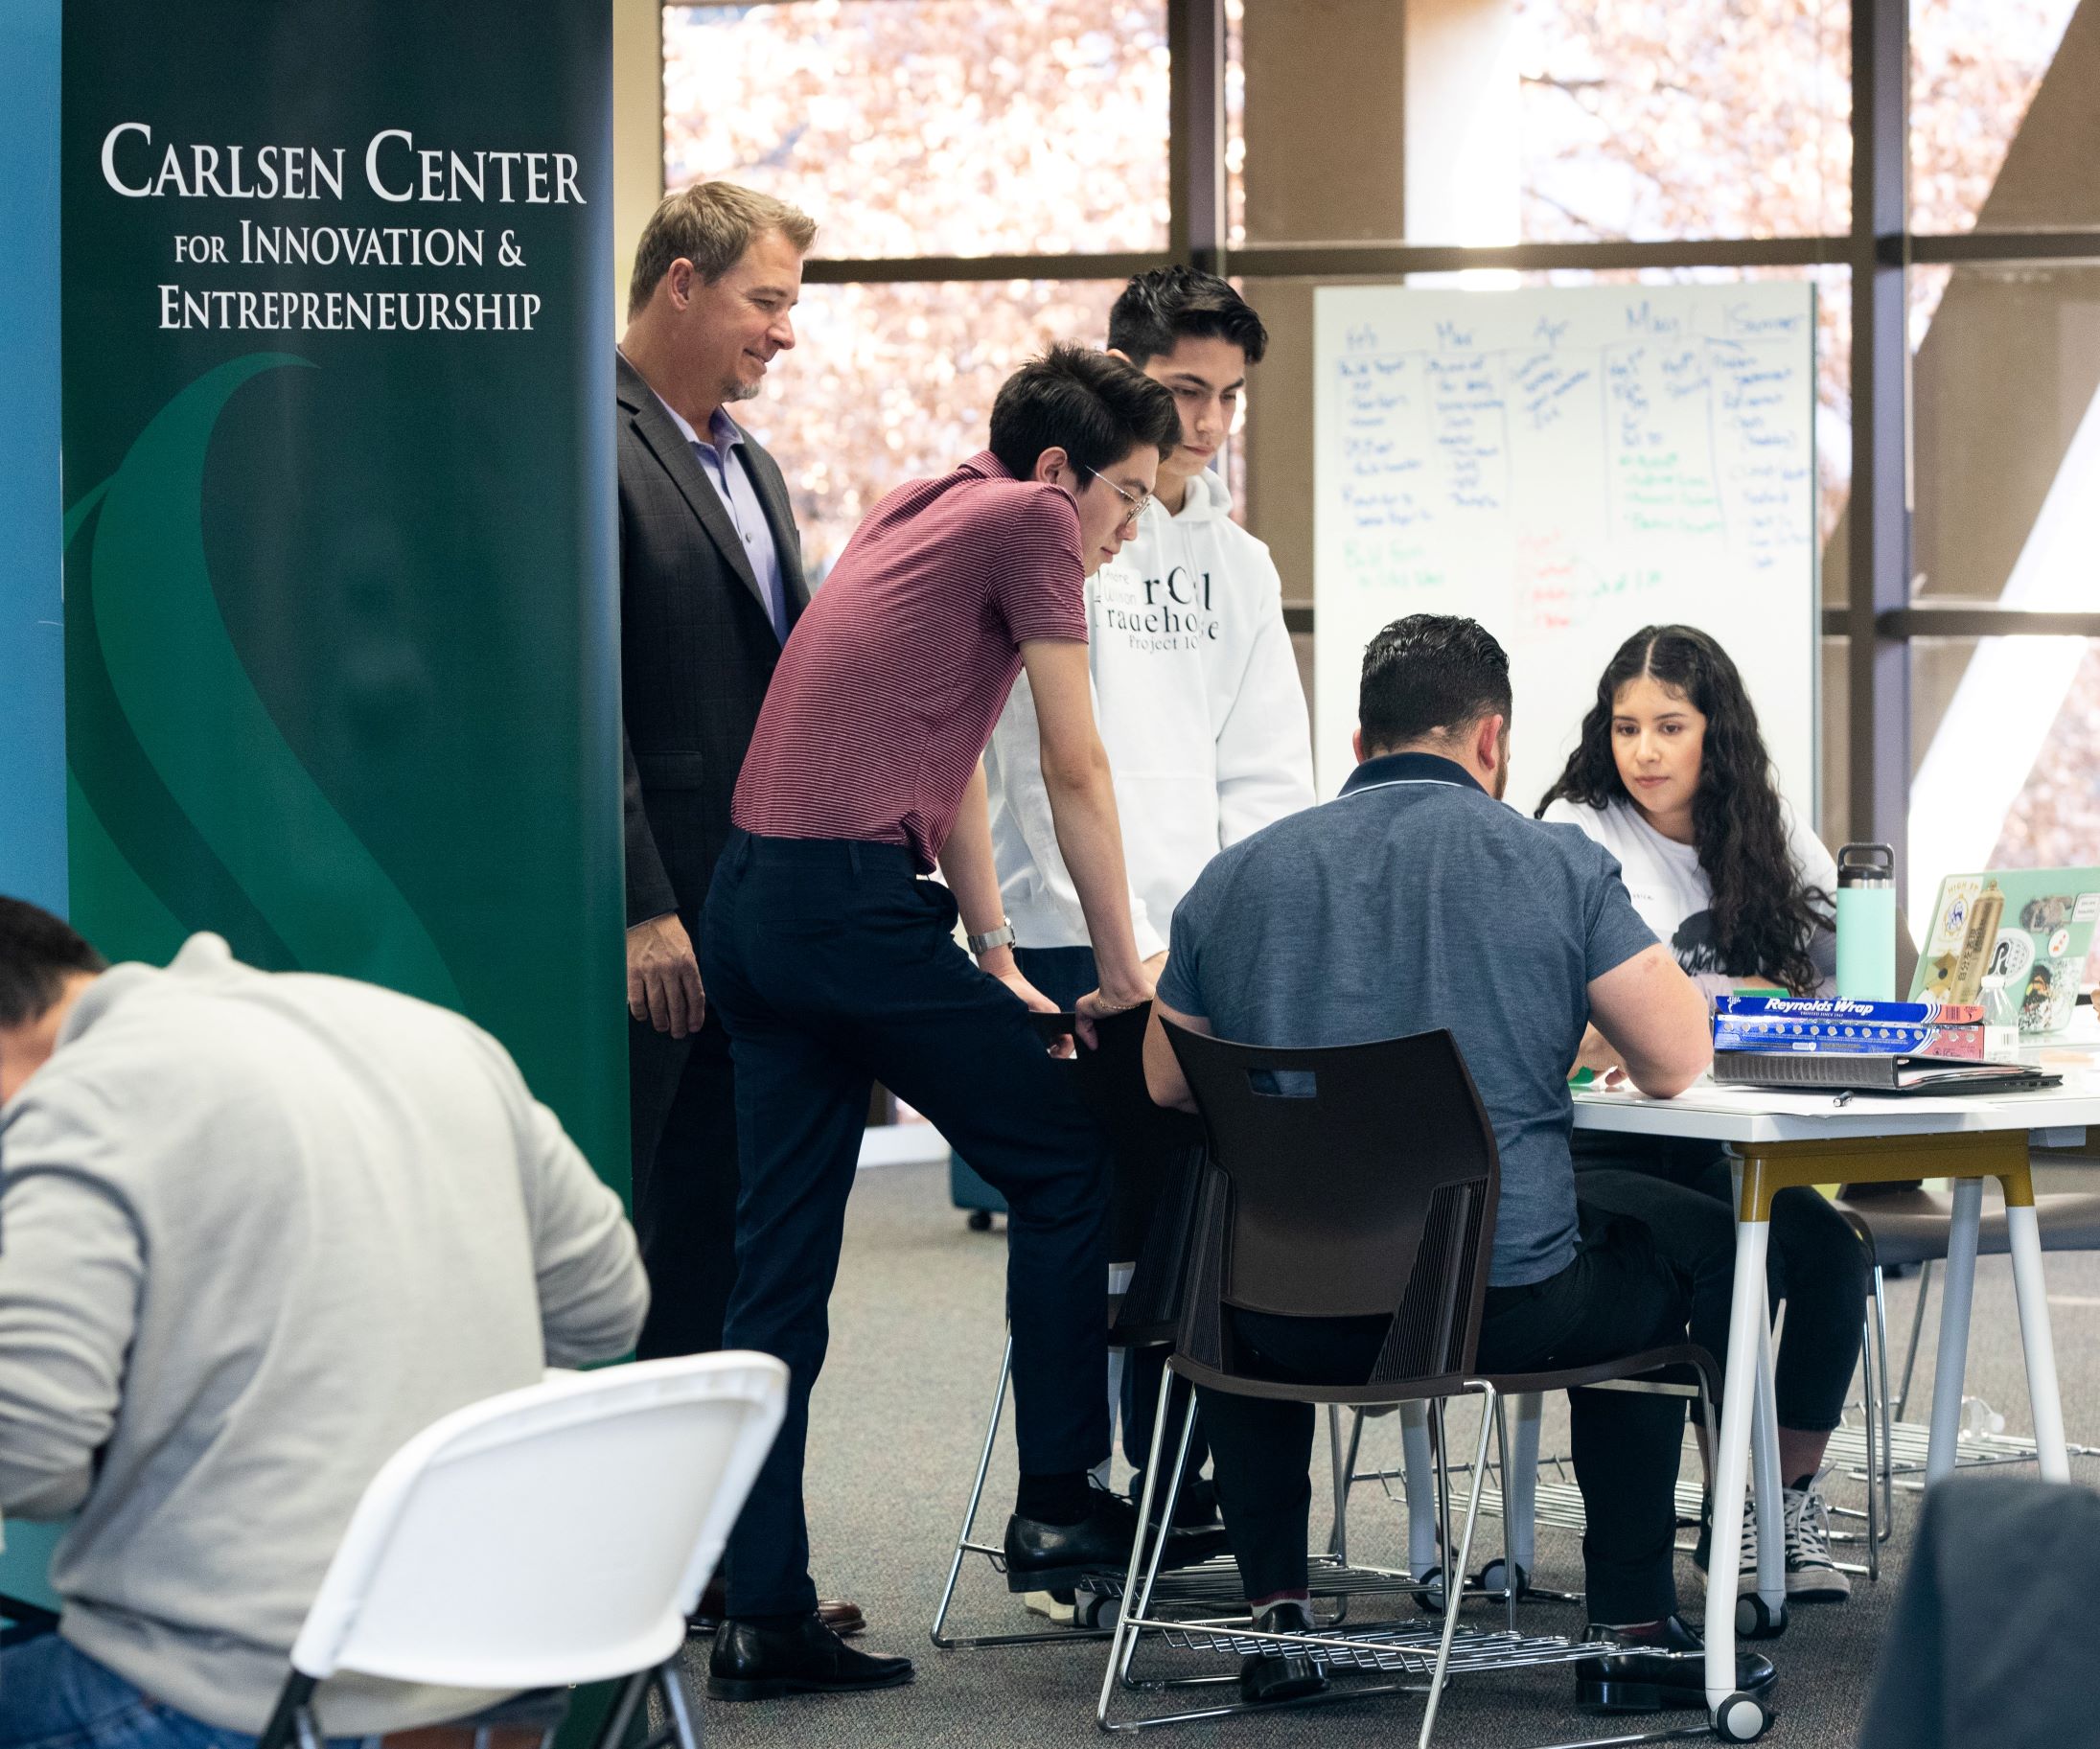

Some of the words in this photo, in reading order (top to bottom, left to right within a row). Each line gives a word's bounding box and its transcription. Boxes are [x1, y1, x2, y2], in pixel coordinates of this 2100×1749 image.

[101, 122, 345, 200] CARLSEN
[364, 128, 587, 205] CENTER
[174, 235, 229, 264] FOR
[239, 219, 484, 267] INNOVATION
[497, 229, 526, 267] &
[157, 285, 541, 332] ENTREPRENEURSHIP
[1765, 998, 1833, 1013] Reynolds
[1835, 999, 1875, 1016] Wrap
